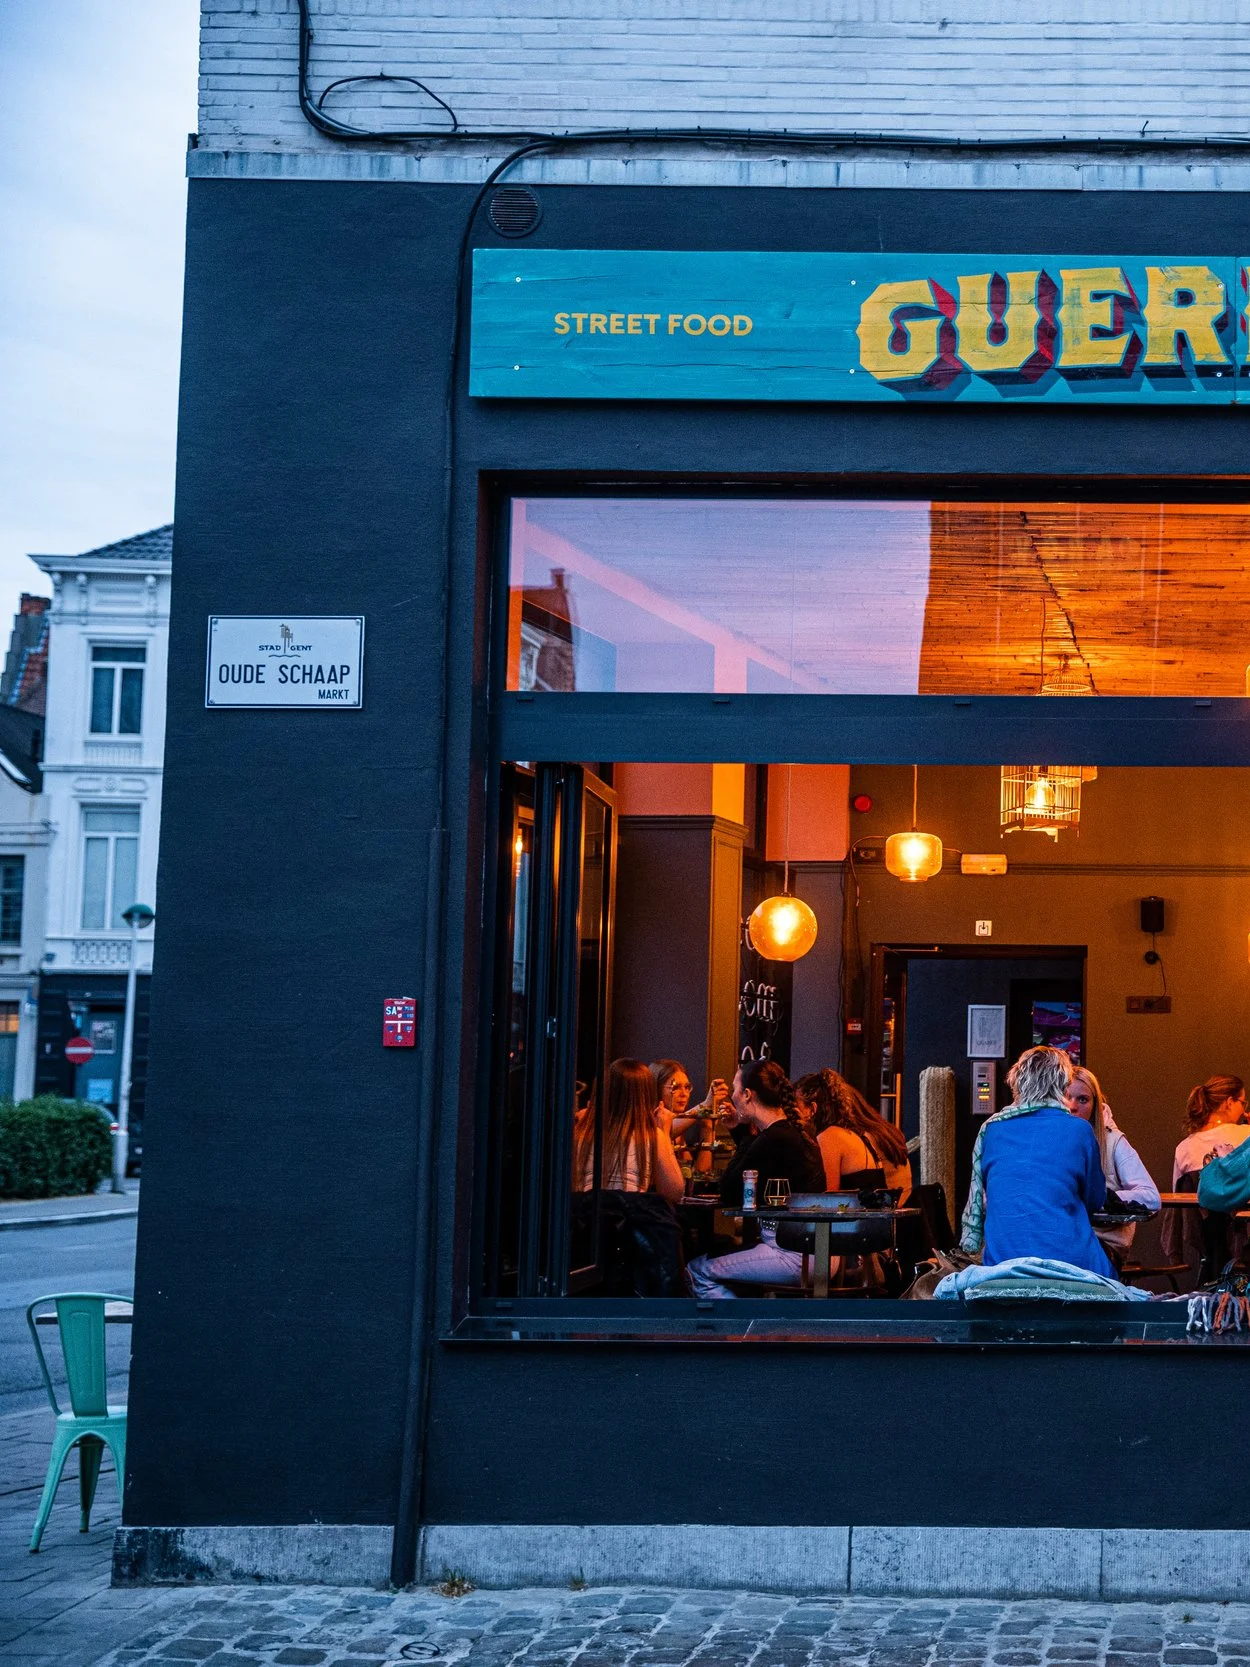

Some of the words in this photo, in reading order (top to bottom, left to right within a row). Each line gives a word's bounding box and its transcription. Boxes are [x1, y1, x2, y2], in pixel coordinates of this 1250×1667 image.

[554, 312, 661, 335] STREET
[668, 314, 753, 336] FOOD
[218, 664, 266, 684] OUDE
[278, 664, 351, 684] SCHAAP
[318, 689, 350, 700] MARKT
[385, 1006, 397, 1015] SA
